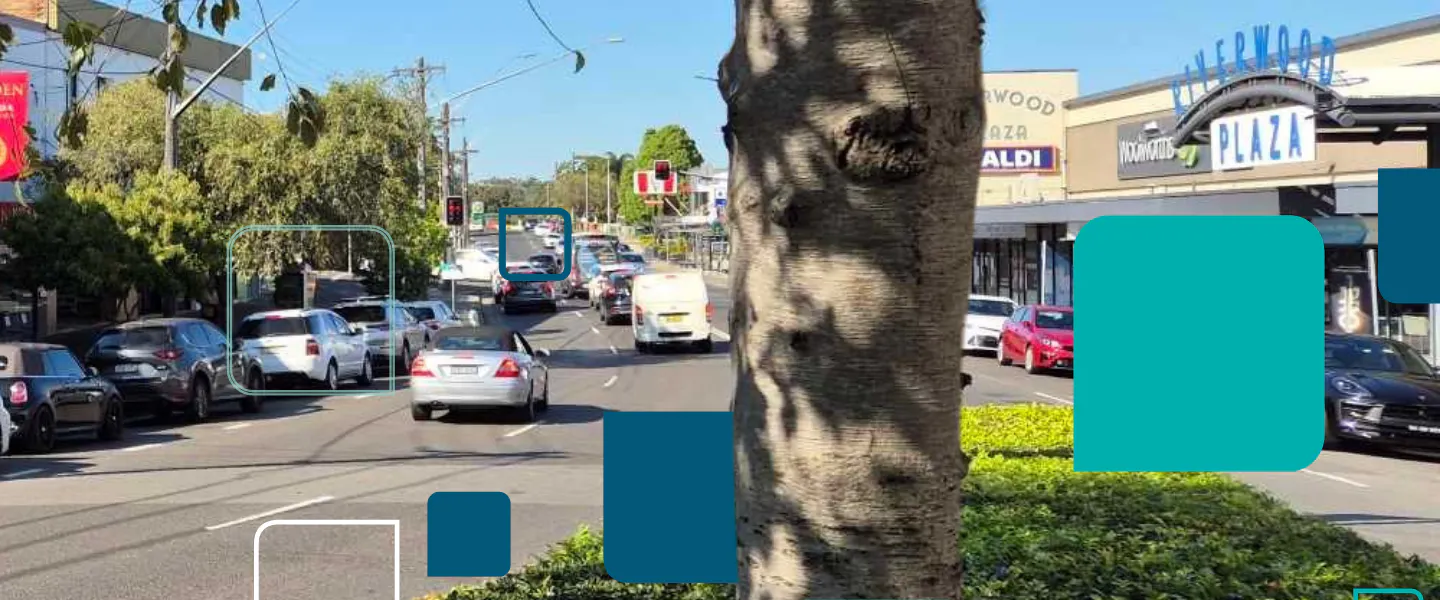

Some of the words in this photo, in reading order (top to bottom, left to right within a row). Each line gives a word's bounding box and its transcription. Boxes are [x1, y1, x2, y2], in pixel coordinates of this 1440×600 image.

[1171, 24, 1337, 118] RIVERWOOD
[981, 149, 1041, 169] ALDI
[1218, 112, 1303, 166] PLAZA
